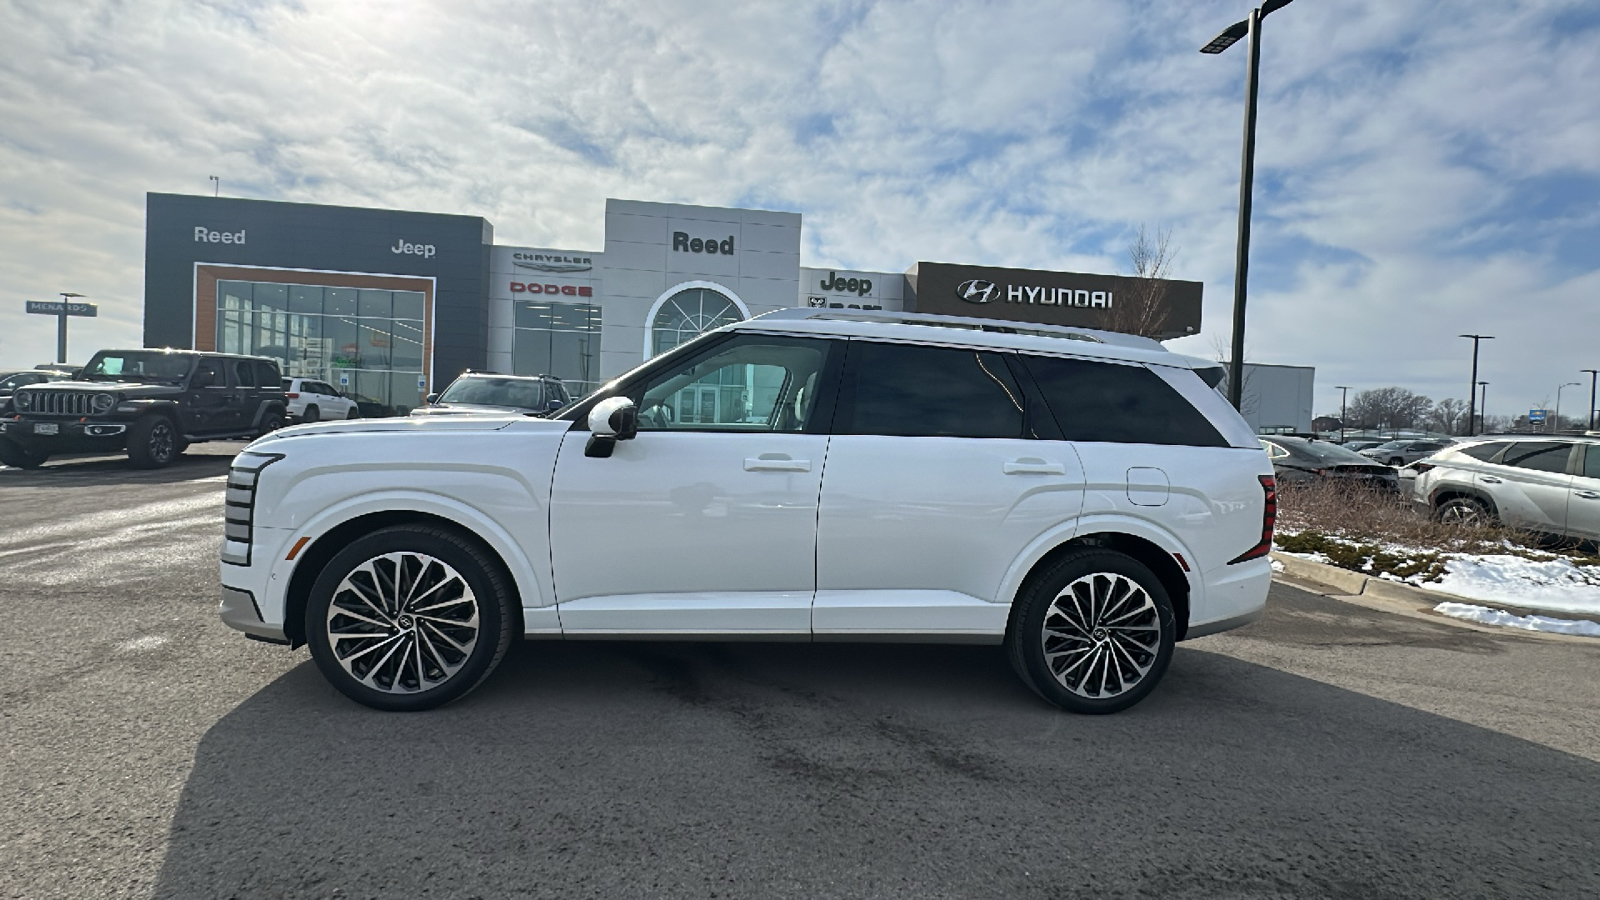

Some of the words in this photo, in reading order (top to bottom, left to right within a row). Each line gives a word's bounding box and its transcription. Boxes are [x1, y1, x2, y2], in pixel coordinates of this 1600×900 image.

[194, 226, 246, 245] Reed
[673, 231, 734, 256] Reed
[391, 239, 436, 259] Jeep
[513, 252, 593, 265] CHRYSLER
[510, 281, 593, 297] DODGE
[820, 271, 872, 297] Jeep
[1007, 284, 1113, 309] HYUNDAI
